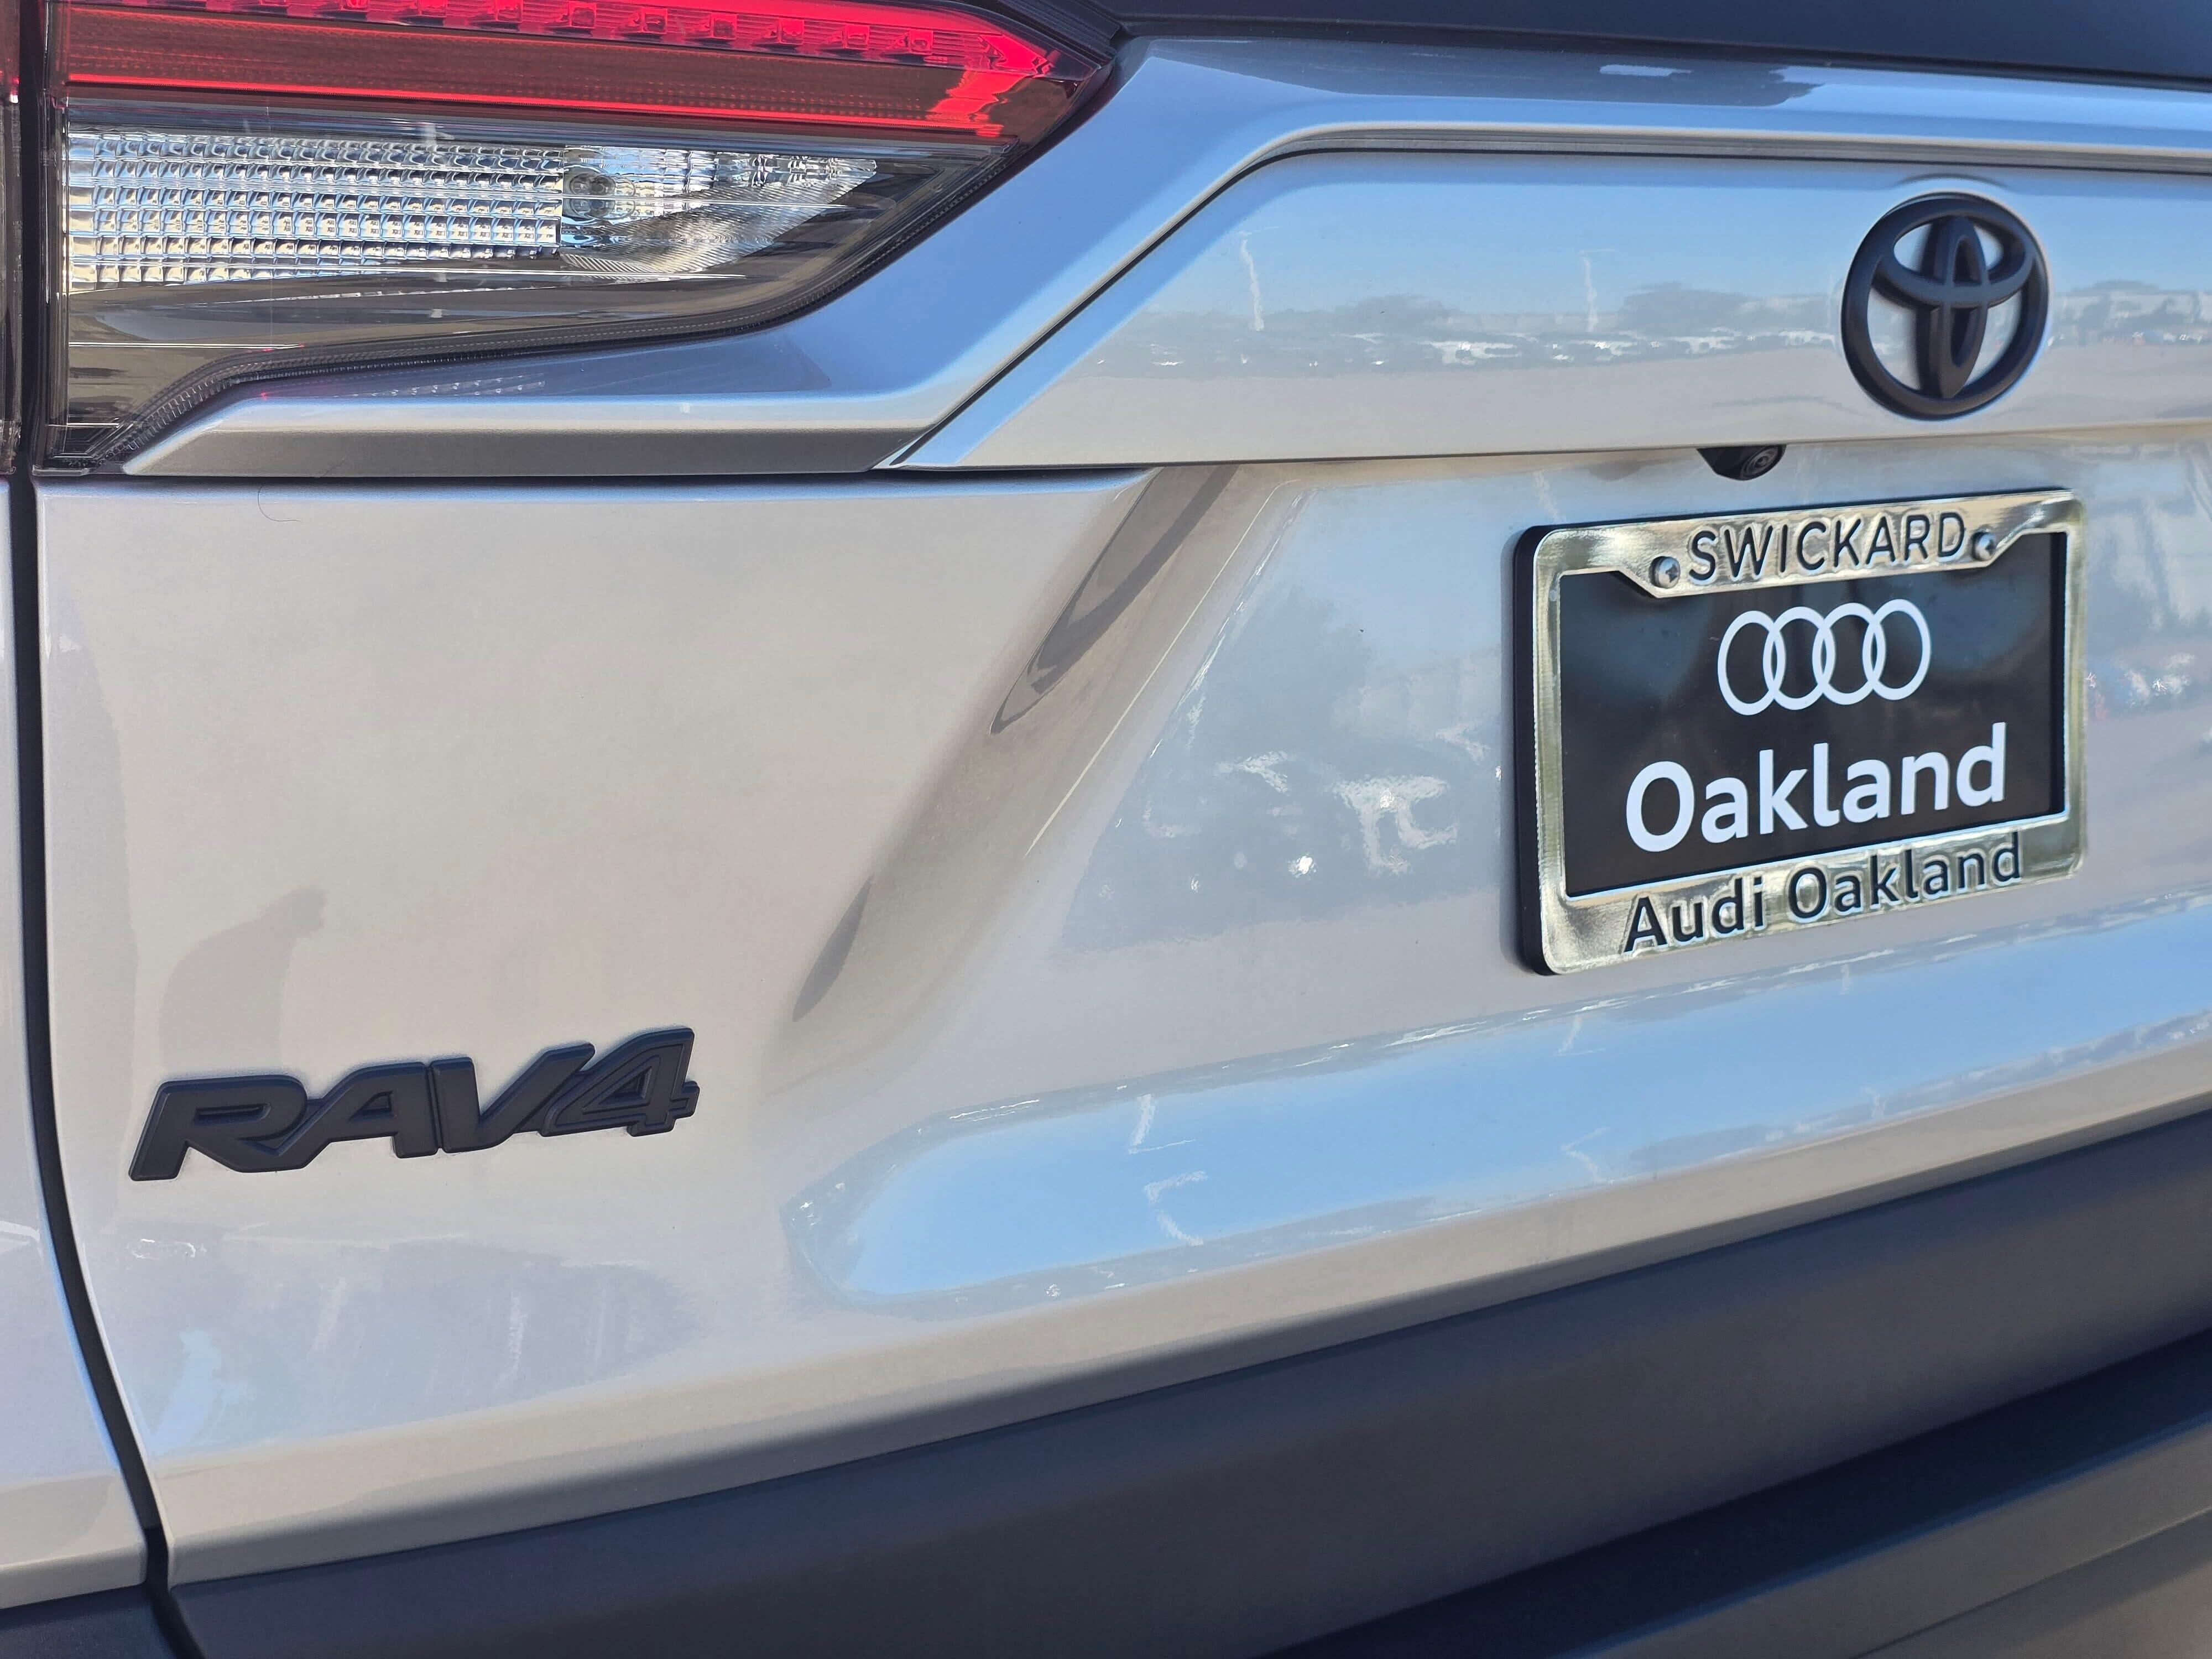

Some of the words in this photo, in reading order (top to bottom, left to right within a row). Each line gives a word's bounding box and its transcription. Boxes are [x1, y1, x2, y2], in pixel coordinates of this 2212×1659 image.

[1688, 511, 1966, 581] SWICKARD
[1625, 722, 2006, 852] Oakland
[1624, 878, 1765, 954] Audi
[1788, 831, 2021, 920] Oakland
[128, 1027, 699, 1181] RAV4
